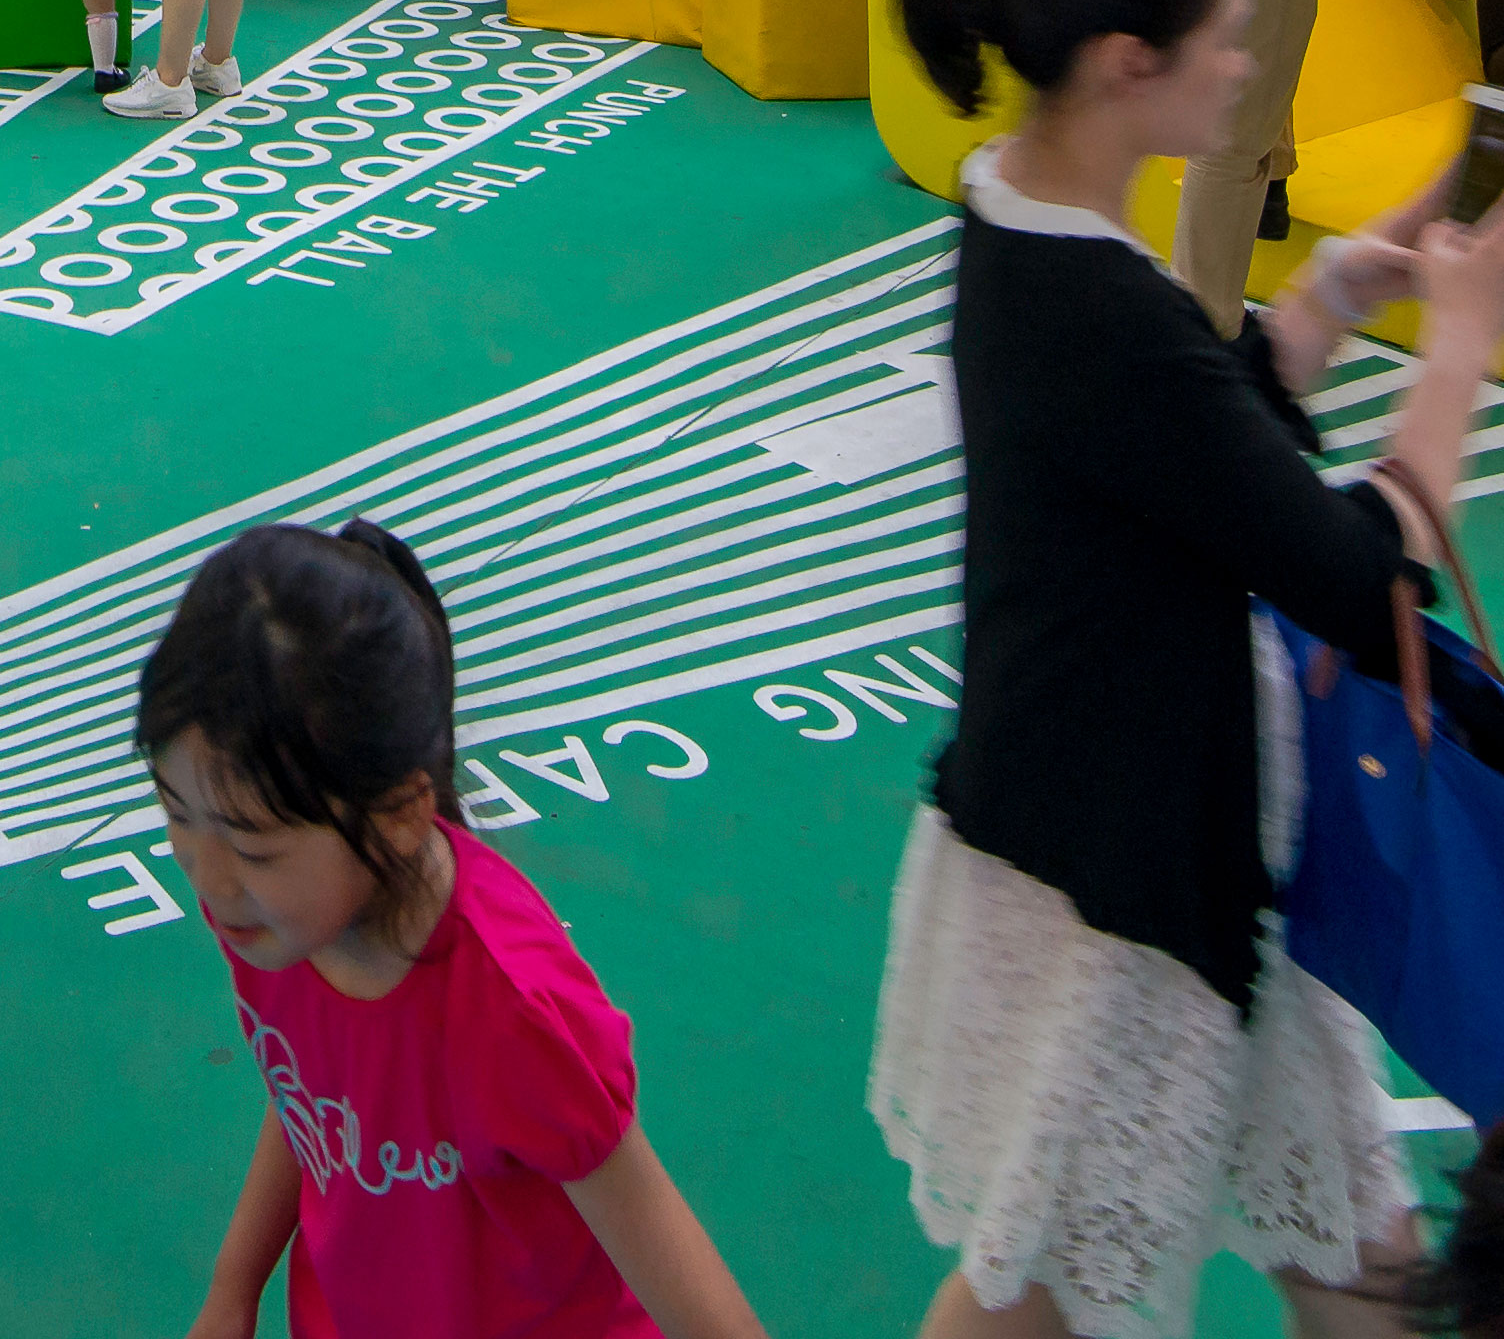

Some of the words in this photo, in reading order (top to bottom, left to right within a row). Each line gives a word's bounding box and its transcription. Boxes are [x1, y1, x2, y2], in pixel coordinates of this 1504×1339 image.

[513, 78, 687, 155] PUNCH
[404, 161, 546, 214] THE
[246, 214, 437, 287] BALL
